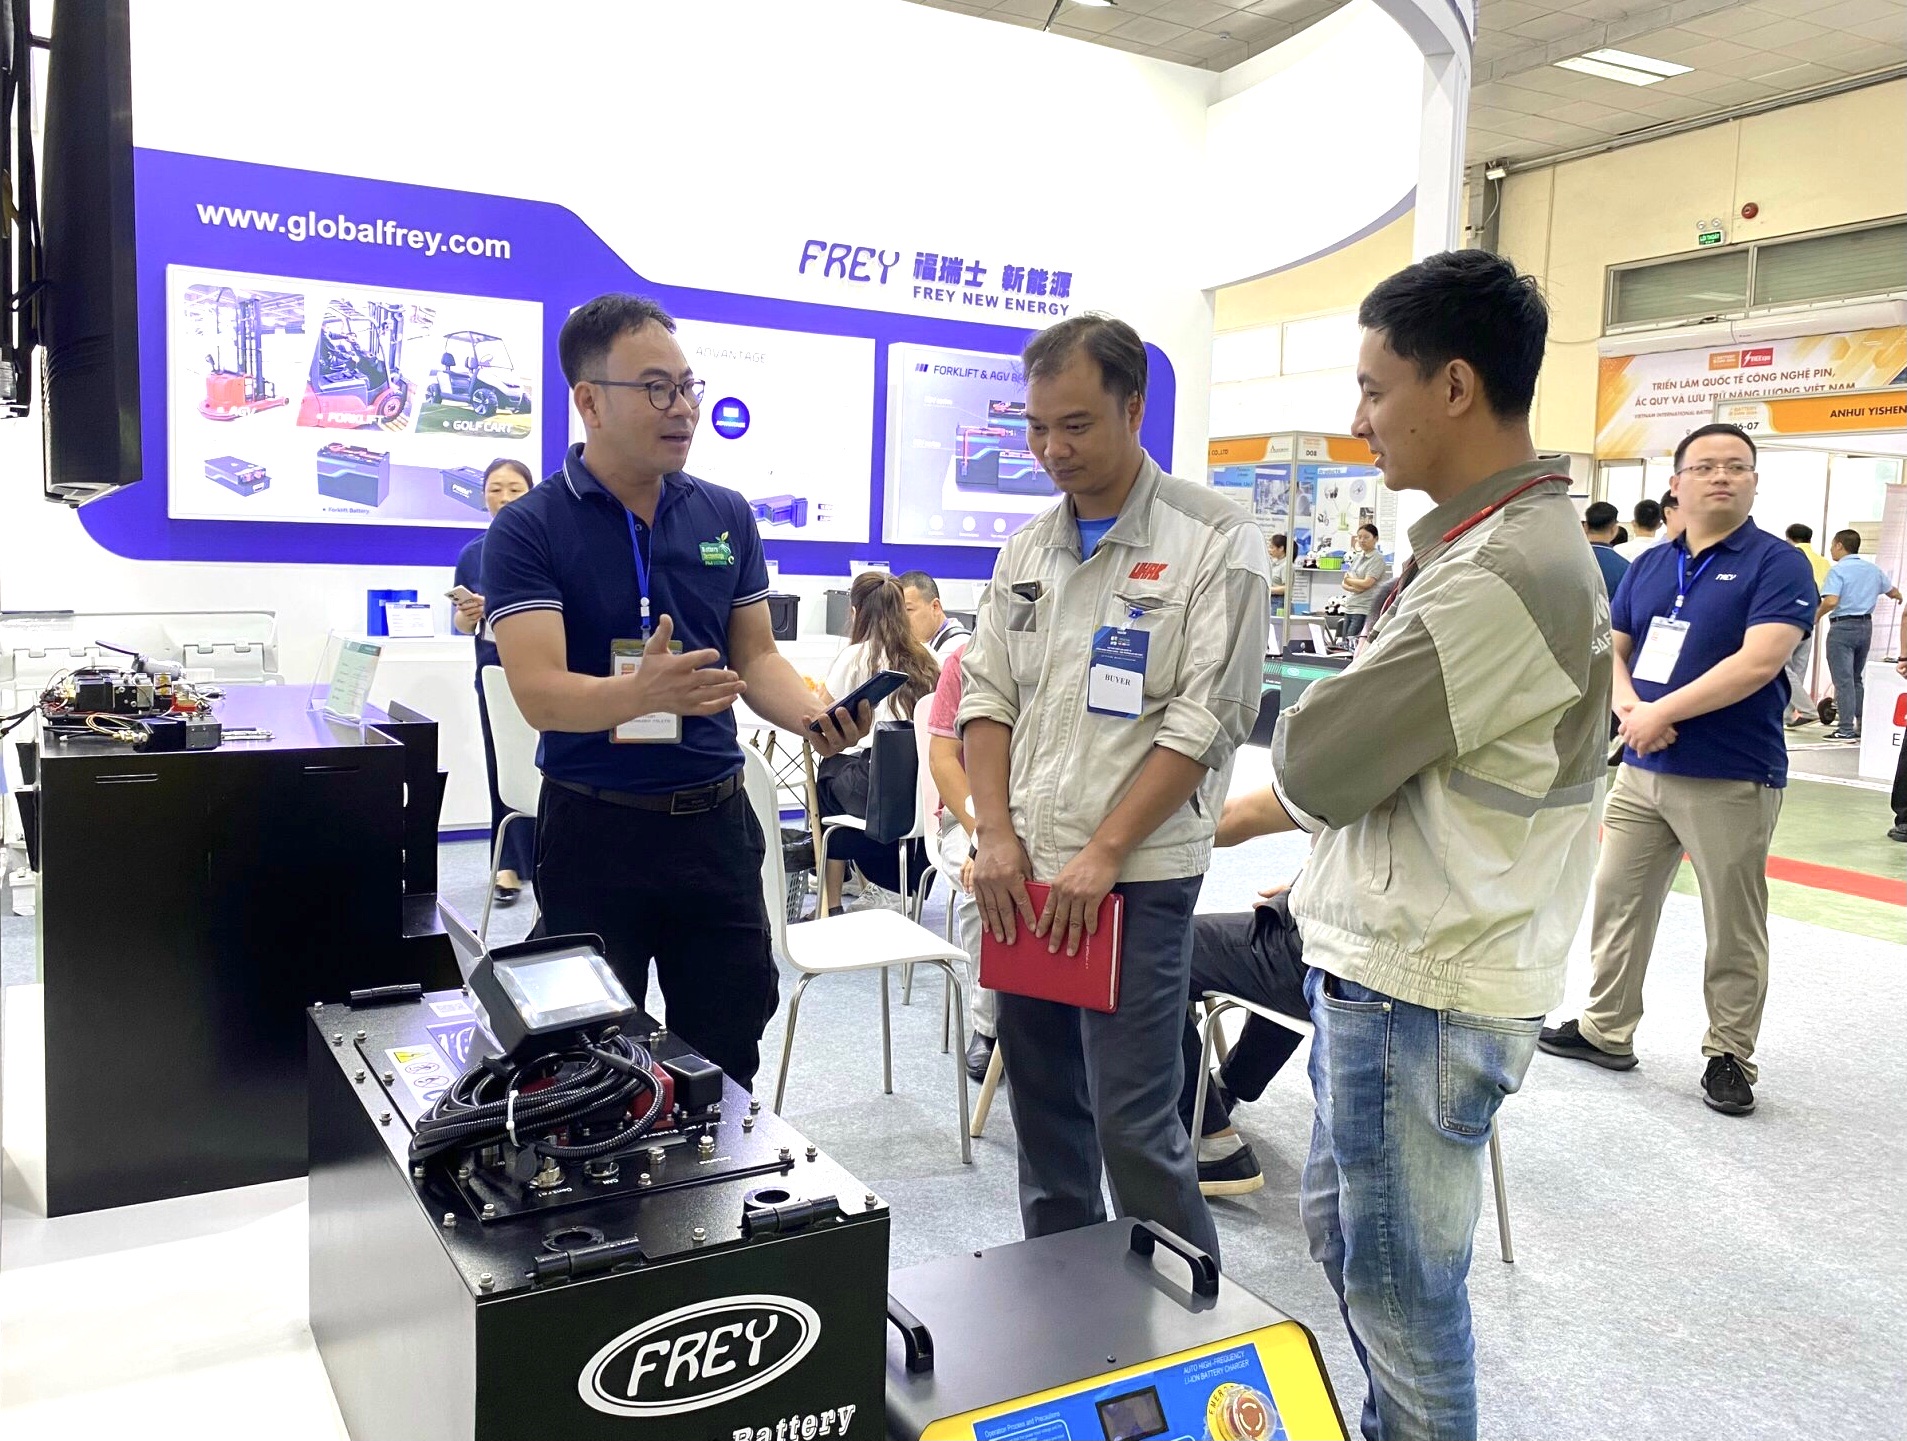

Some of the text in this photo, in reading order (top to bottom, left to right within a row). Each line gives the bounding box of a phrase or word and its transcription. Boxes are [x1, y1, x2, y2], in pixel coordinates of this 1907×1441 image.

[196, 203, 511, 259] www.globalfrey.com
[798, 239, 900, 284] FREY
[912, 251, 1073, 298] 福瑞士 新能源
[913, 286, 1070, 316] FREY NEW ENERGY
[934, 365, 979, 379] FORKLIFT
[980, 370, 988, 380] &
[990, 371, 1010, 381] AGV
[327, 412, 386, 425] FORKLIFT
[1830, 408, 1865, 418] ANHUI
[453, 420, 513, 433] GOLF CART
[1105, 674, 1131, 686] BUYER
[627, 1314, 778, 1397] FREY
[1183, 1363, 1198, 1374] AUTO
[1200, 1367, 1224, 1380] BATTERY
[1224, 1359, 1250, 1373] CHARGER
[732, 1404, 856, 1441] Battery
[1025, 1418, 1035, 1427] and
